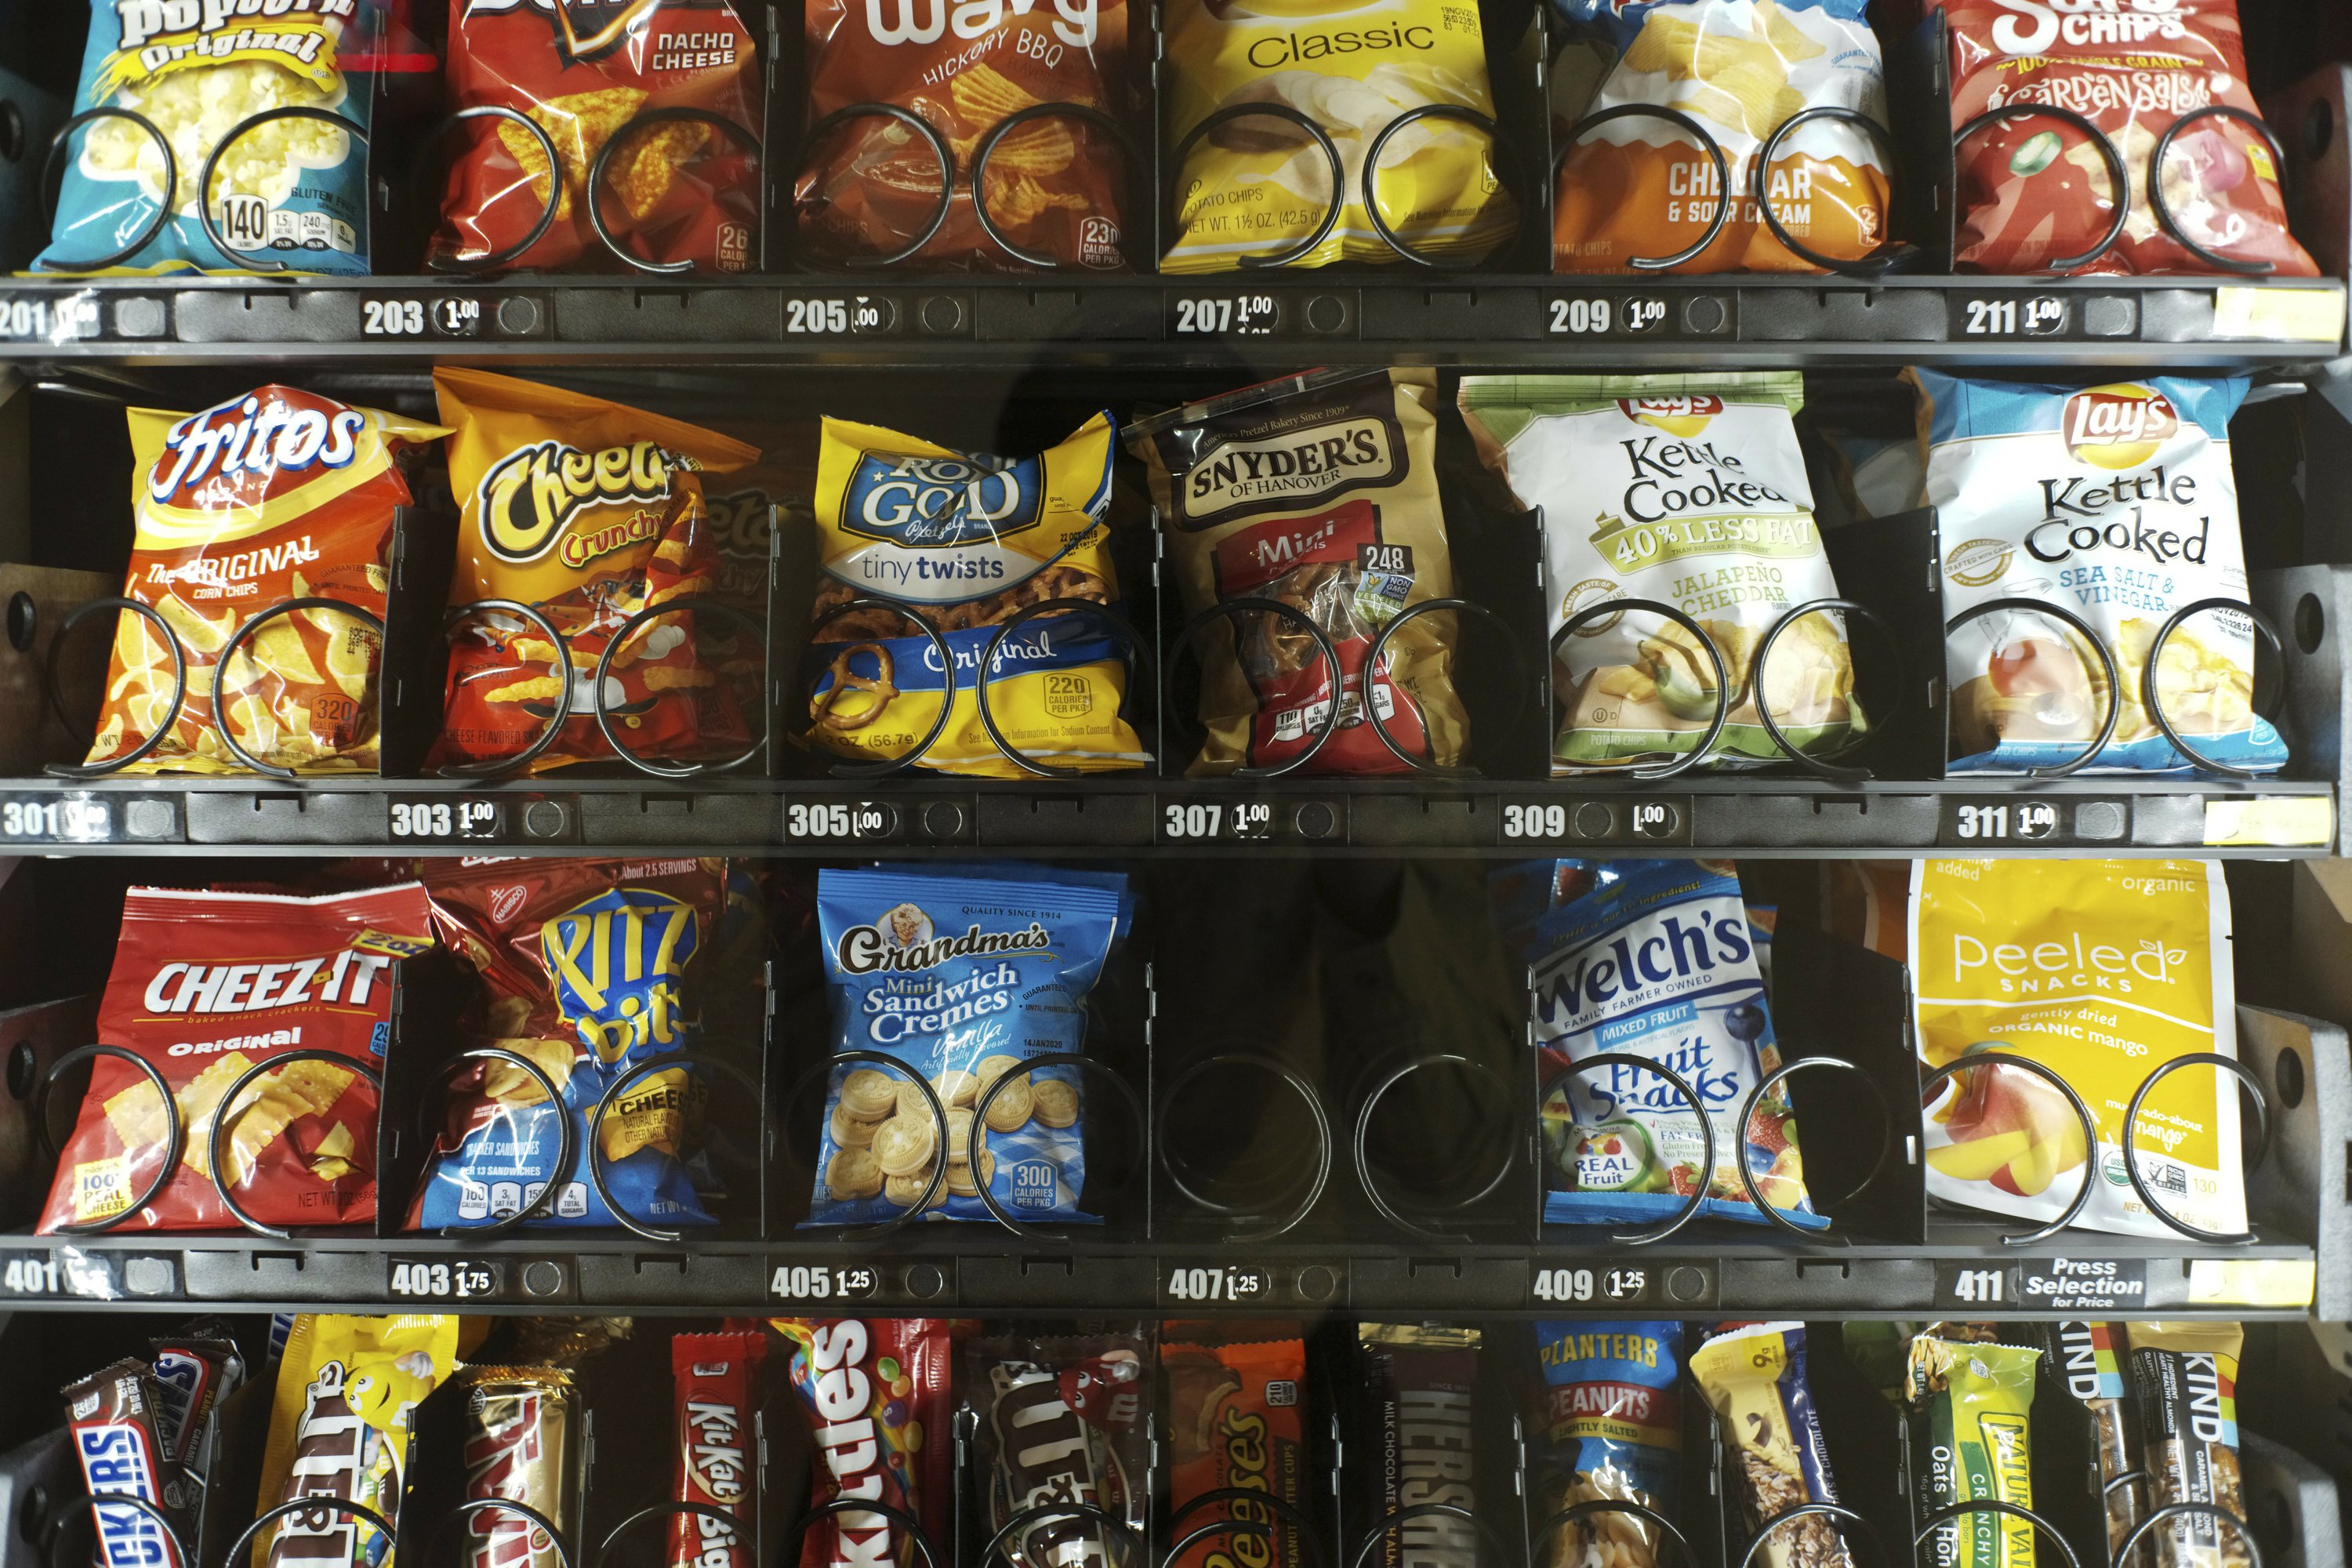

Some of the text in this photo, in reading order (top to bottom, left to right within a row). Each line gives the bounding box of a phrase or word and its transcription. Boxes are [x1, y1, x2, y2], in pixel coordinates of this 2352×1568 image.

[658, 32, 735, 50] NACHO
[1247, 21, 1435, 68] Classic
[2062, 13, 2186, 45] CHIPS
[139, 29, 326, 72] Original
[652, 50, 735, 71] CHEESE
[924, 27, 1063, 85] HICKORY BBQ
[291, 187, 333, 204] GLUTEN
[337, 196, 358, 216] FREE
[1185, 188, 1263, 219] POTATO CHIPS
[1668, 201, 1681, 222] &
[224, 199, 265, 241] 140
[1085, 220, 1118, 245] 230
[1185, 212, 1276, 234] NET WT. OZ.
[0, 302, 45, 336] 201
[364, 299, 480, 334] 203 1.00
[787, 299, 847, 333] 205
[1177, 295, 1272, 333] 207 1.00
[1549, 299, 1666, 333] 209 1.00
[1966, 299, 2062, 334] 211 1.00
[1203, 411, 1323, 449] America's Pretzel Bakery Since
[2071, 394, 2169, 445] Lay's
[153, 396, 365, 505] Fritos
[1193, 428, 1379, 499] SNYDER'S
[1620, 436, 1744, 481] Kettle
[1230, 469, 1342, 499] OF HANOVER
[1623, 469, 1788, 524] Cooked
[2038, 465, 2197, 521] Kettle
[561, 509, 666, 567] Crunchy
[1257, 520, 1334, 567] Mini
[1614, 517, 1813, 565] 40% LESS FAT
[2024, 506, 2209, 565] Cooked
[183, 535, 320, 588] ORIGINAL
[862, 554, 1004, 585] tiny twists
[1366, 546, 1405, 570] 248
[1944, 557, 1976, 574] CRAFTED
[193, 582, 258, 600] CORN CHIPS
[1386, 583, 1408, 594] GMO
[1390, 576, 1410, 588] NON
[2059, 565, 2175, 594] SEA SALT &
[1680, 586, 1788, 619] CHEDDAR
[2074, 586, 2169, 613] VINEGAR
[923, 630, 1058, 673] Original
[1048, 695, 1088, 706] CALORIES
[1049, 677, 1085, 695] 220
[317, 699, 352, 720] 320
[1051, 703, 1087, 714] PER PKG
[867, 731, 919, 750] (56.7g)
[1590, 734, 1646, 746] POTATO CHIPS
[3, 802, 57, 835] 301
[392, 802, 493, 836] 303 1.00
[788, 804, 848, 837] 305
[1166, 803, 1270, 837] 307 1.00
[1504, 804, 1565, 837] 309
[1957, 804, 2054, 838] 311 1.00
[622, 859, 697, 880] About SERVINGS
[1936, 862, 1980, 882] added
[2122, 874, 2196, 896] organic
[495, 885, 525, 923] NABISCO
[1639, 880, 1701, 906] ingredient!
[961, 906, 1062, 920] QUALITY SINCE 1914
[543, 904, 696, 1012] RITZ
[840, 923, 1051, 974] Grandma's
[1954, 932, 2166, 982] peeled
[1537, 910, 1751, 1025] Welch's
[2000, 973, 2132, 993] SNACKS
[863, 962, 1017, 1014] Sandwich
[886, 976, 932, 994] Mini
[1022, 983, 1067, 1000] GUARANTEED
[1564, 974, 1713, 1029] FAMILY FARMER OWNED
[267, 1004, 321, 1018] crackers
[869, 988, 1009, 1043] Cremes
[1602, 1006, 1689, 1043] MIXED FRUIT
[2020, 1006, 2117, 1028] gently dried
[1023, 1039, 1063, 1048] 14JAN2020
[1988, 1022, 2149, 1058] ORGANIC mango
[1611, 1036, 1713, 1092] Fruit
[1589, 1069, 1739, 1122] Snacks
[622, 1113, 653, 1130] NATURAL
[625, 1128, 648, 1143] OTHER
[487, 1166, 541, 1176] SANDWICHES
[1017, 1165, 1051, 1187] 300
[1574, 1158, 1634, 1172] REAL
[1584, 1172, 1624, 1185] Fruit
[298, 1192, 318, 1208] NET
[1014, 1187, 1054, 1198] CALORIES
[1016, 1197, 1051, 1208] PER PKG
[2194, 1178, 2217, 1194] 130
[85, 1200, 127, 1215] CHEESE
[5, 1259, 60, 1294] 401
[391, 1263, 489, 1298] 403 1.75
[771, 1266, 870, 1298] 405 1.25
[2052, 1258, 2117, 1276] Press
[1168, 1267, 1258, 1301] 407 1.25
[1534, 1269, 1645, 1301] 409 1.25
[1955, 1269, 2003, 1301] 411
[2025, 1276, 2144, 1295] Selection
[2051, 1296, 2114, 1308] for Price
[1541, 1334, 1659, 1371] PLANTERS
[2167, 1362, 2179, 1400] INGREDIENT
[2181, 1352, 2223, 1443] KIND
[1549, 1385, 1650, 1418] PEANUTS
[2161, 1371, 2176, 1434] HEALTHY ALMONDS
[1559, 1420, 1638, 1439] LIGHTLY SALTED
[1806, 1407, 1833, 1471] CHOCOLATE
[1286, 1443, 1296, 1472] CUPS
[1385, 1400, 1396, 1504] MILK CHOCOLATE
[1932, 1446, 1951, 1494] Oats
[2195, 1450, 2205, 1497] CARAMEL
